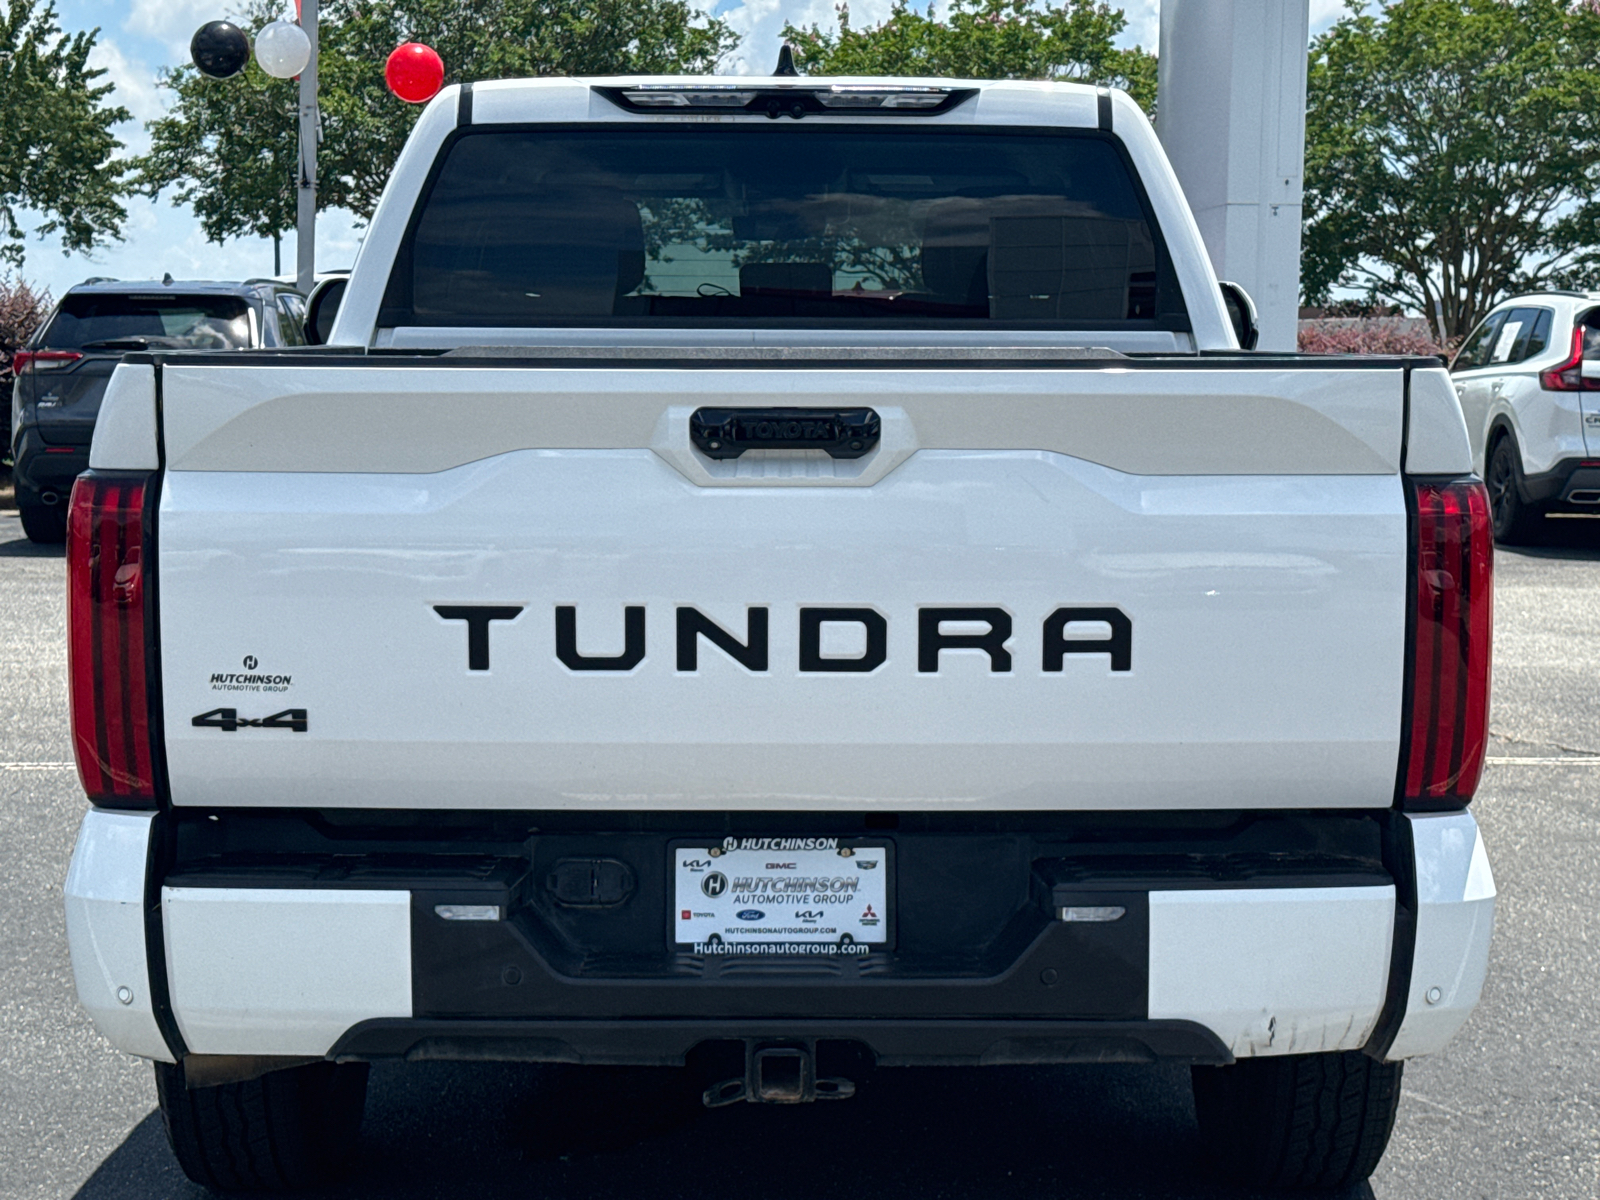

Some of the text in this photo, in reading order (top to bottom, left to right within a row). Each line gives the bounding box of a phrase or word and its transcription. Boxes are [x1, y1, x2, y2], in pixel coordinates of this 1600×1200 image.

[743, 420, 831, 440] TOYOTA
[432, 605, 1133, 673] TUNDRA
[210, 673, 292, 686] HUTCHINSON
[211, 683, 289, 693] AUTOMOTIVE GROUP
[191, 707, 308, 732] 4x4
[740, 838, 839, 851] HUTCHINSON
[765, 862, 798, 870] GMC
[731, 876, 860, 893] HUTCHINSON
[733, 894, 854, 904] AUTOMOTIVE GROUP
[741, 911, 760, 919] Ford
[694, 941, 870, 954] Hutchinsonautogroup.com
